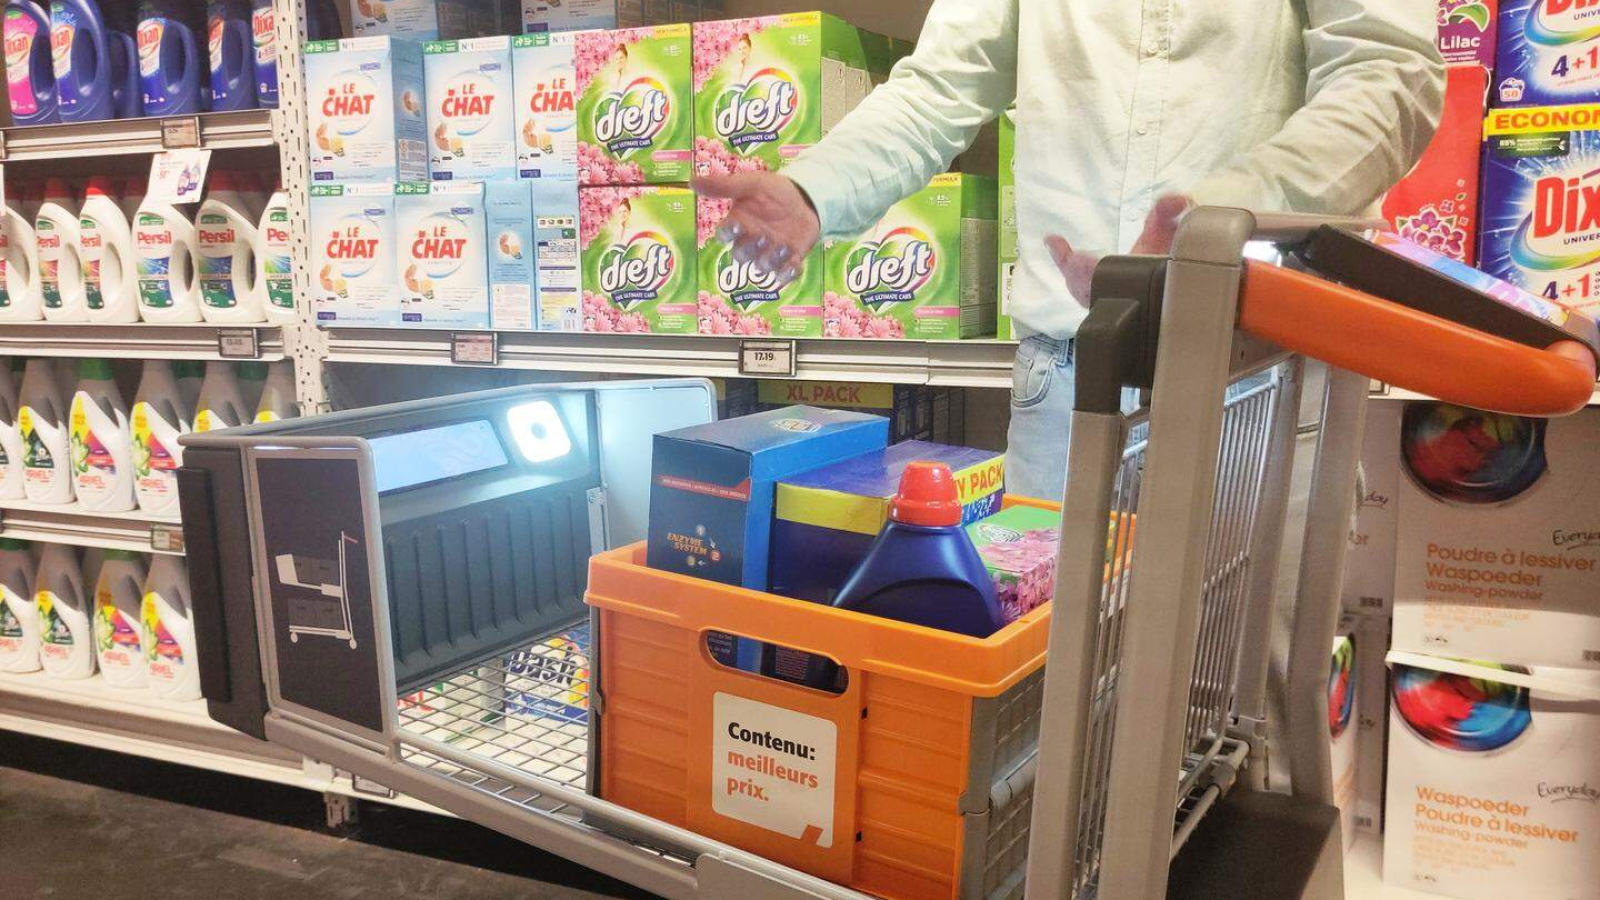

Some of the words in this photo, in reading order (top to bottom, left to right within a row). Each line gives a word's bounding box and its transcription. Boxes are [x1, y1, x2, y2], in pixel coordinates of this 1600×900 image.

[1440, 35, 1481, 50] Lilac
[343, 83, 355, 94] LE
[463, 84, 475, 94] LE
[552, 78, 566, 90] LE
[322, 94, 375, 117] CHAT
[441, 95, 495, 117] CHAT
[530, 90, 576, 112] CHA
[717, 81, 793, 136] dreft
[597, 90, 666, 141] dreft
[741, 134, 763, 144] ULTIMATE
[137, 231, 172, 245] Persil
[199, 229, 236, 243] Persil
[347, 226, 359, 238] LE
[433, 226, 447, 237] LE
[326, 238, 379, 259] CHAT
[411, 238, 467, 259] CHAT
[601, 244, 672, 292] dreft
[718, 258, 776, 293] dre
[848, 241, 932, 294] dreft
[787, 385, 808, 401] XL
[812, 385, 861, 403] PACK
[970, 463, 1003, 494] PACK
[667, 532, 702, 545] ENZYME
[1426, 543, 1498, 563] Poudre
[1501, 548, 1517, 565] à
[1520, 551, 1596, 571] lessiver
[1426, 562, 1543, 587] Waspoeder
[728, 721, 816, 761] Contenu:
[727, 751, 819, 790] meilleurs
[727, 776, 770, 802] prix.
[1416, 786, 1529, 817] Waspoeder
[1415, 804, 1484, 828] Poudre
[1488, 814, 1501, 831] à
[1505, 818, 1580, 843] lessiver
